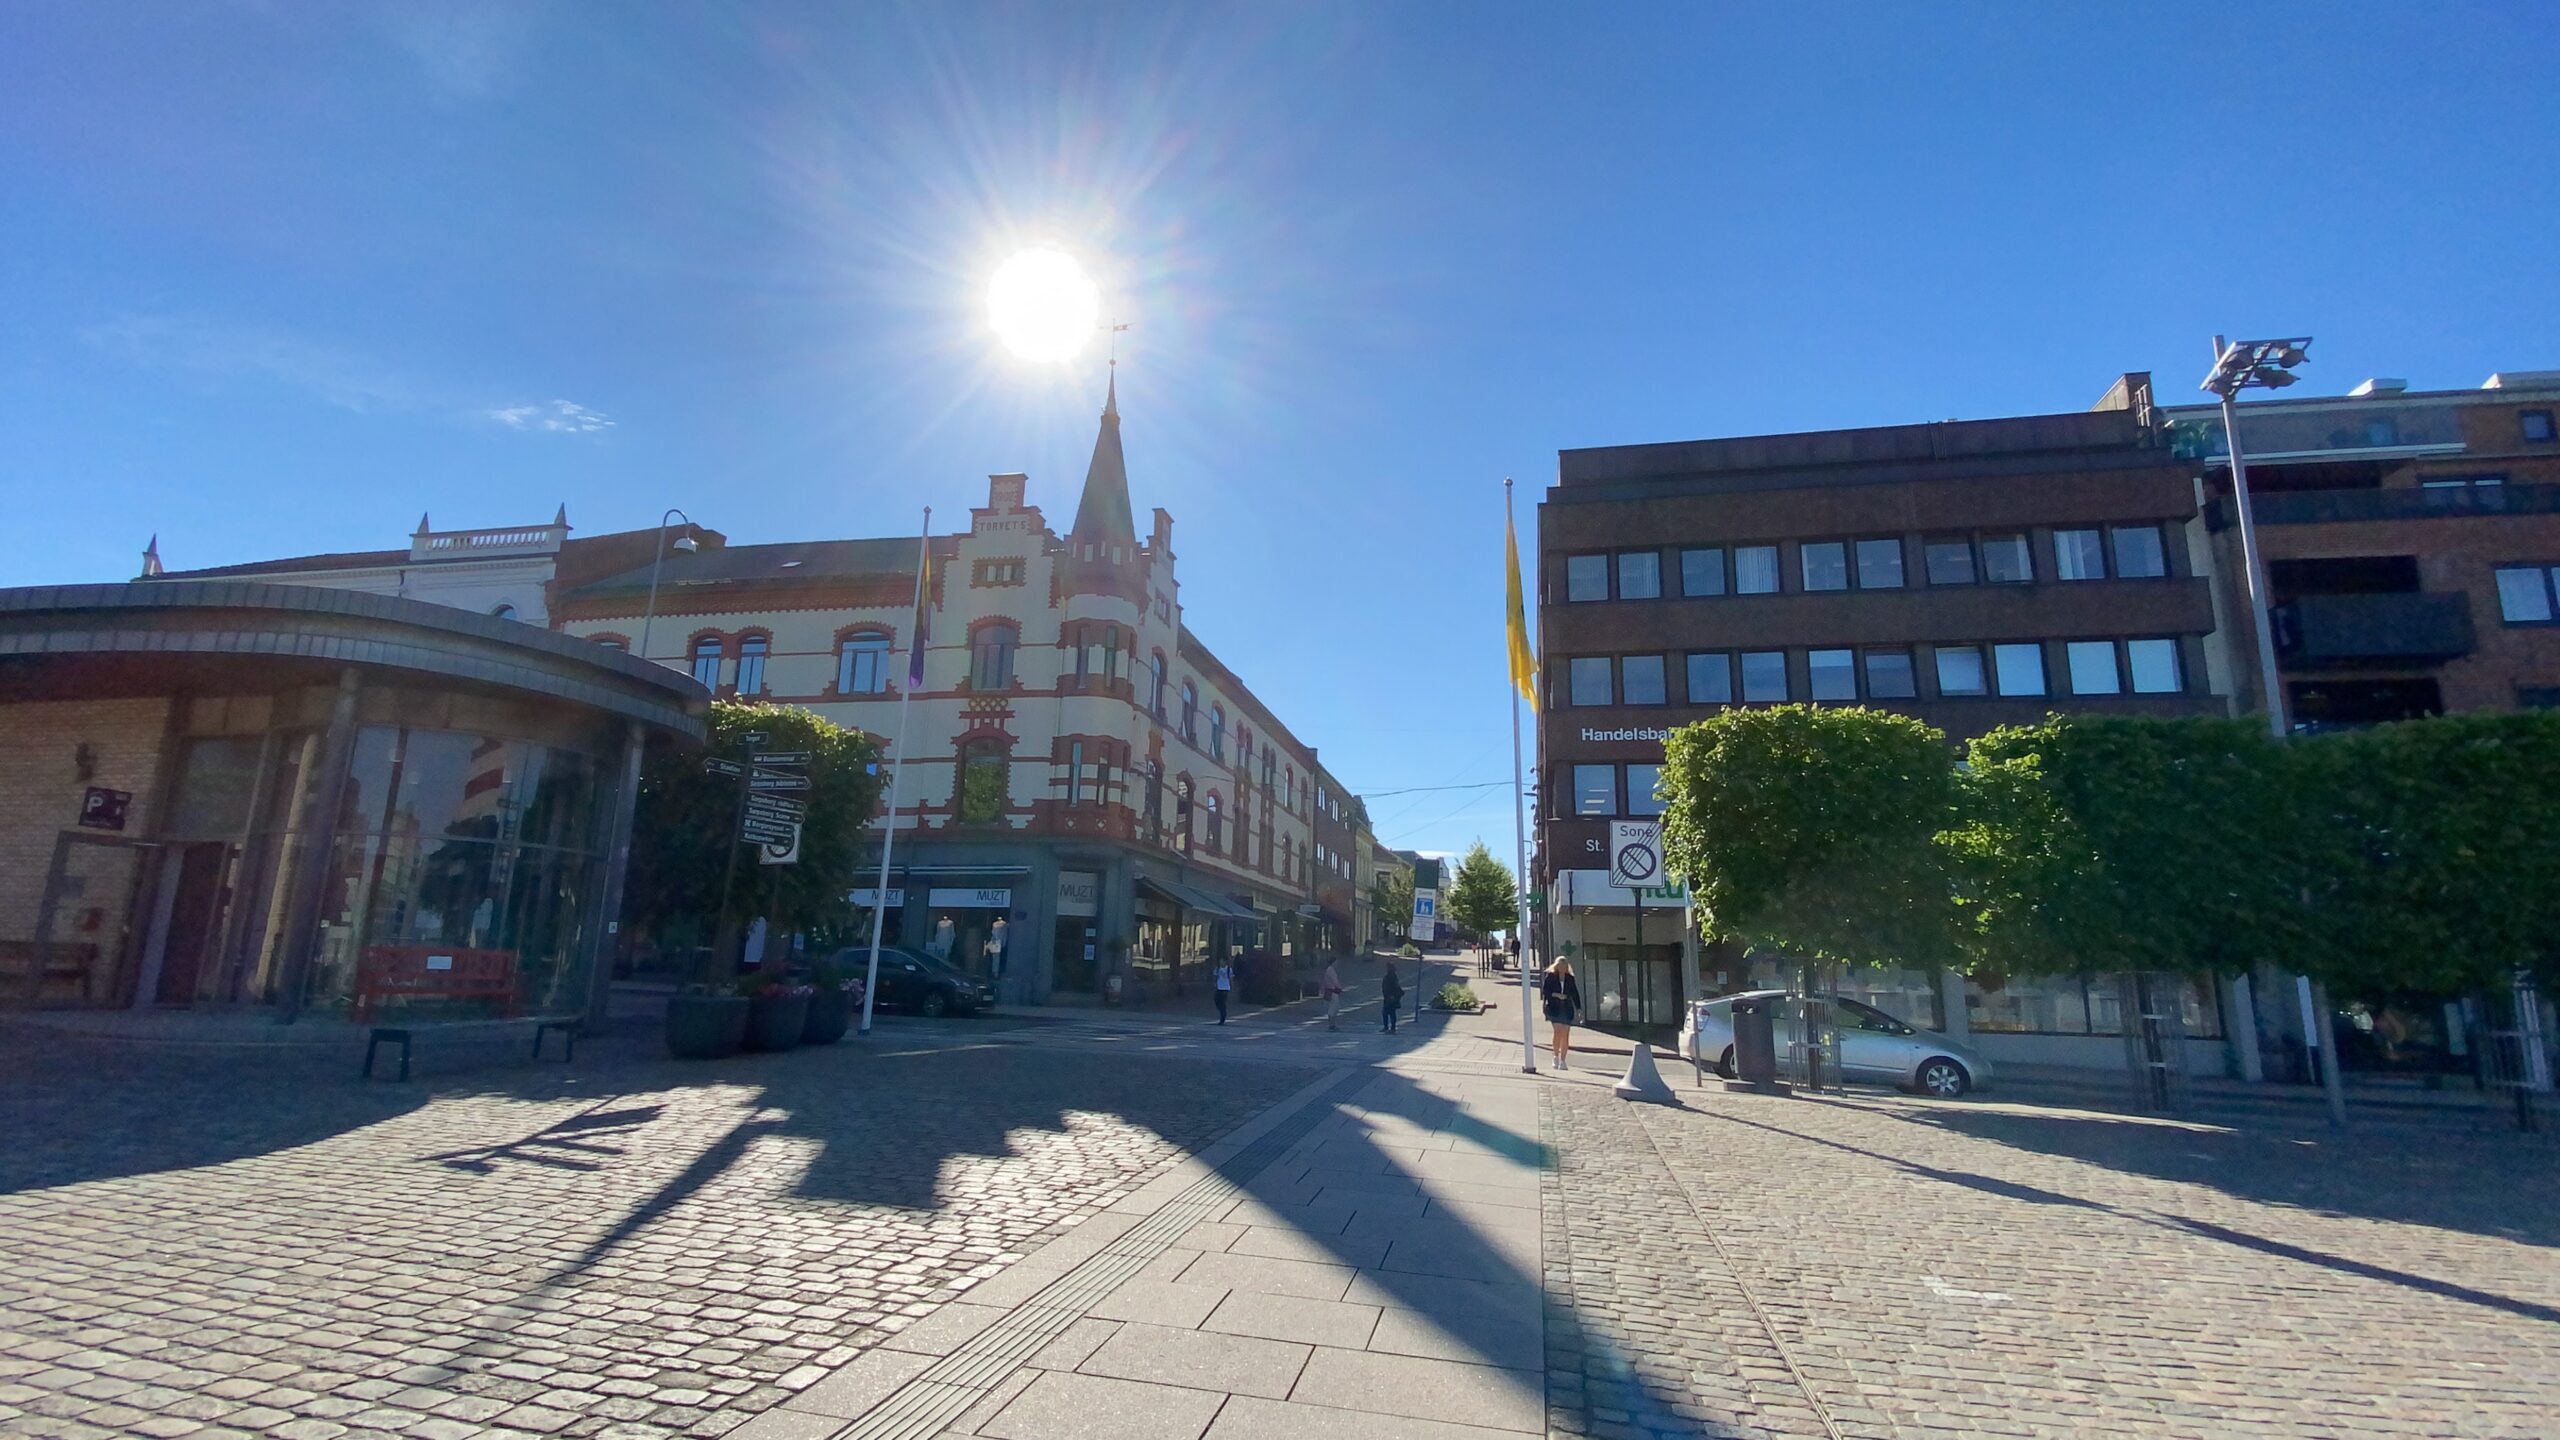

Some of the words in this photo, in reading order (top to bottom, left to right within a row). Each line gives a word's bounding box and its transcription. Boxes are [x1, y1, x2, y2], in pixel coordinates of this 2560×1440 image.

[87, 796, 103, 813] P
[1620, 825, 1653, 837] Sone
[1586, 839, 1604, 852] St.
[976, 890, 1007, 902] MUZT
[1059, 884, 1096, 898] MUZT
